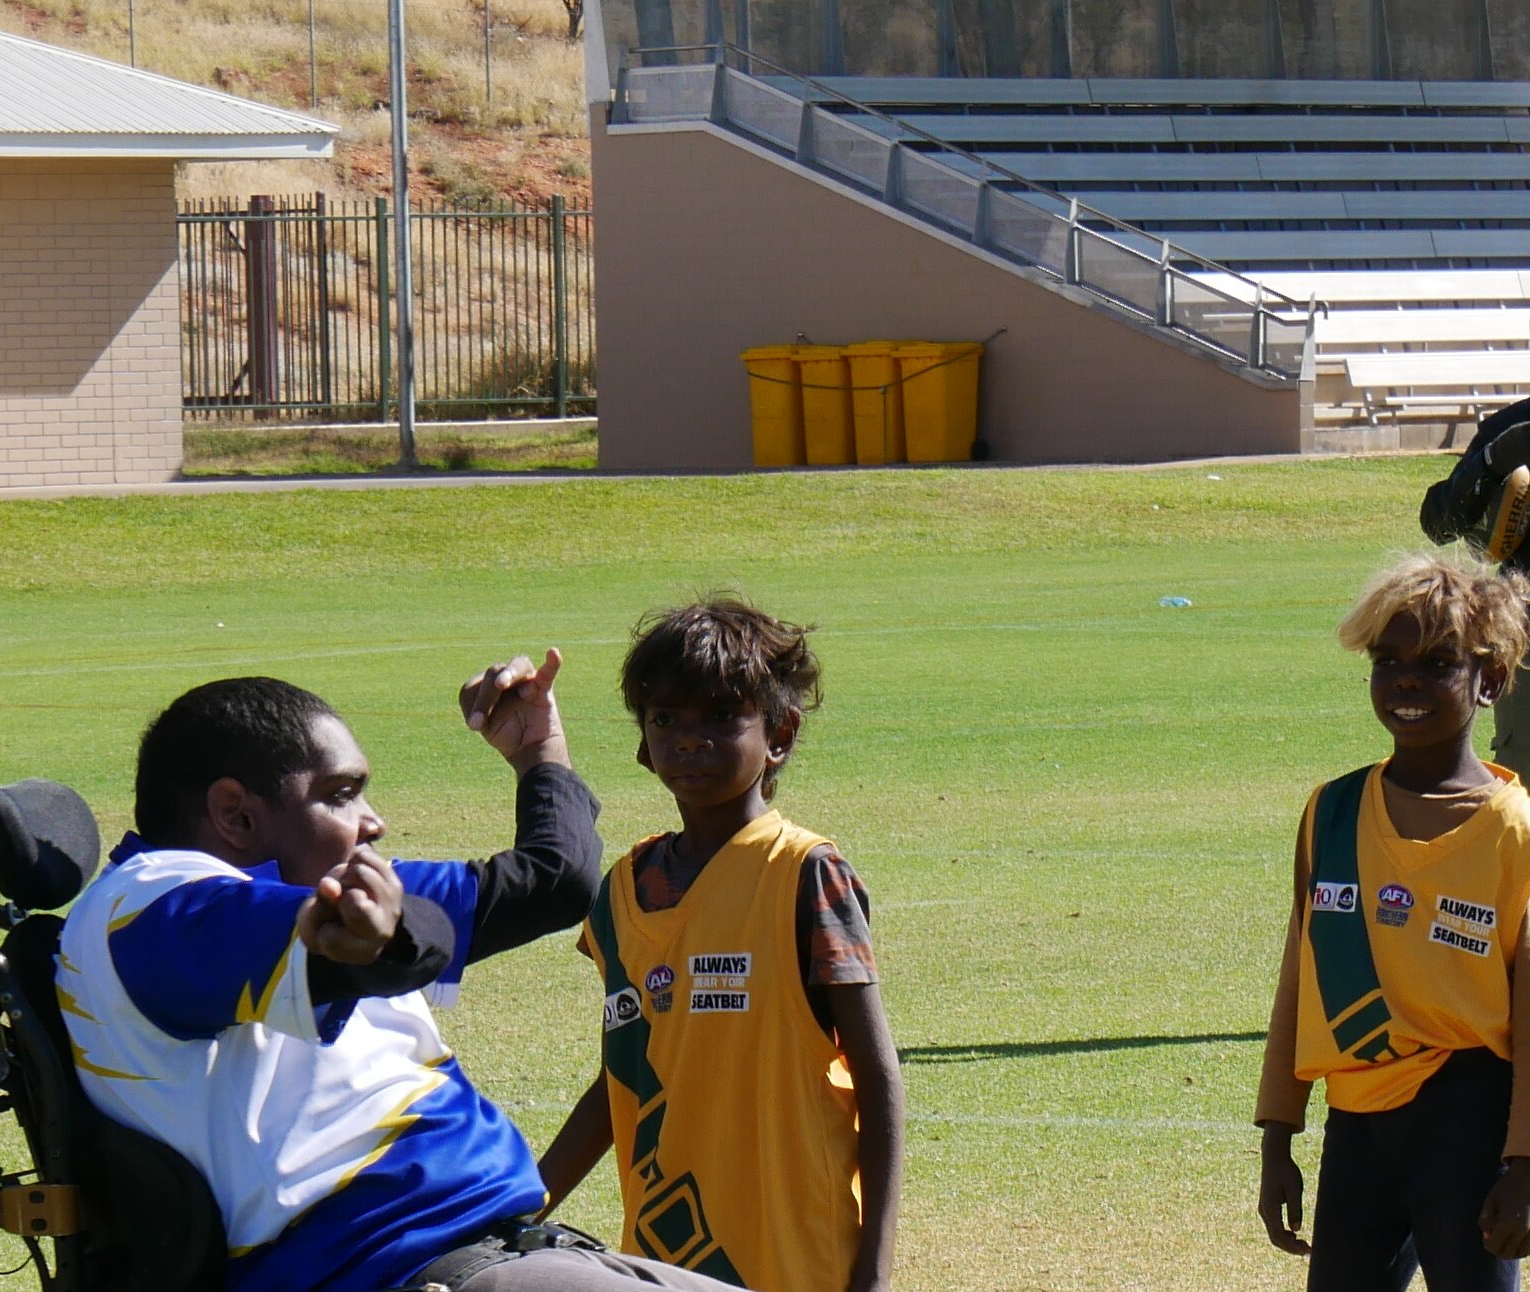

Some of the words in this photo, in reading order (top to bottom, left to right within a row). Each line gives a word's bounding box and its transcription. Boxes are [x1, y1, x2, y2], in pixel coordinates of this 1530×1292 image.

[1382, 889, 1412, 906] AFL
[1439, 898, 1495, 925] ALWAYS
[1433, 926, 1489, 955] SEATBELT
[693, 956, 747, 975] ALWAYS
